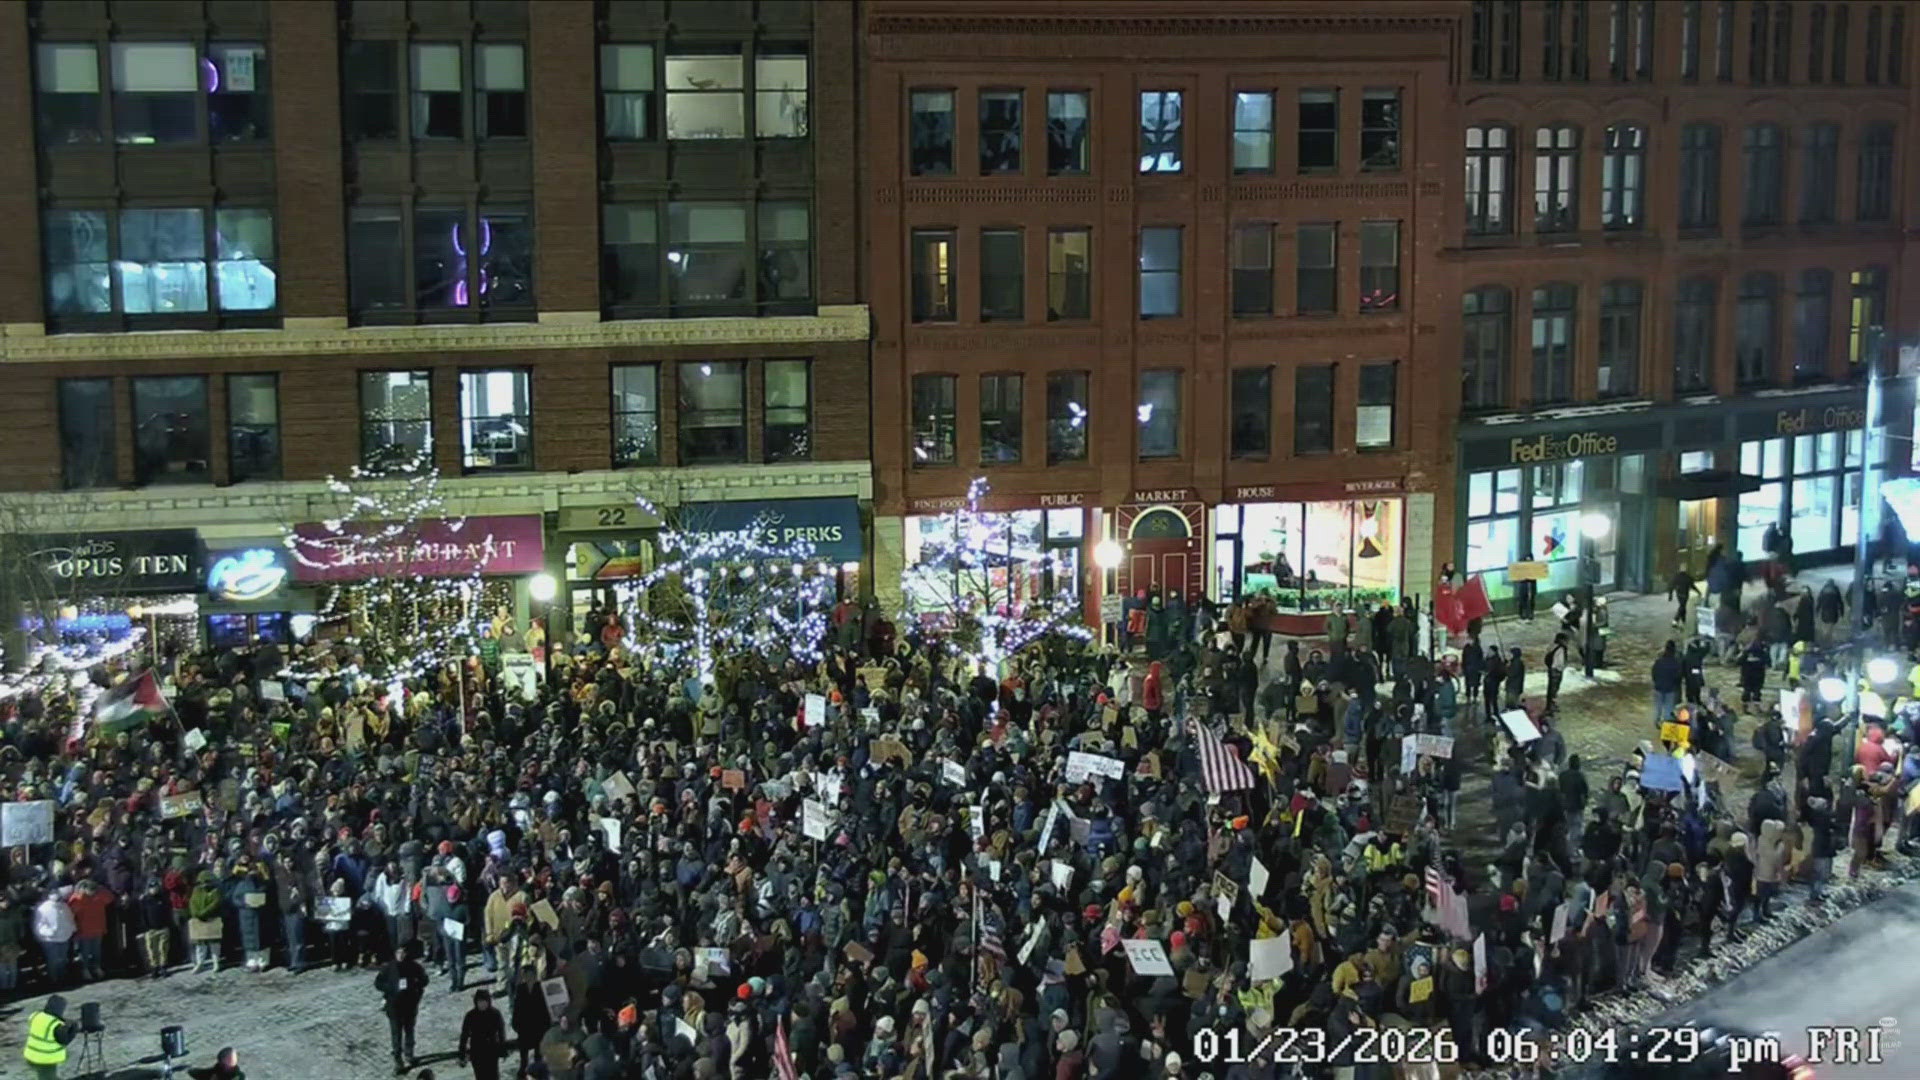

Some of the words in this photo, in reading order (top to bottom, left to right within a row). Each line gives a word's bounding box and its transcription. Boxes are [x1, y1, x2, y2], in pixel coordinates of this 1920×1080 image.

[1567, 432, 1616, 456] Office
[1237, 487, 1275, 499] HOUSE
[1345, 481, 1396, 492] BEVERAGES
[1040, 494, 1084, 505] PUBLIC
[1135, 490, 1187, 501] MARKET
[599, 508, 626, 526] 22
[784, 526, 842, 543] PERKS
[57, 557, 123, 578] OPUS
[136, 555, 188, 575] TEN
